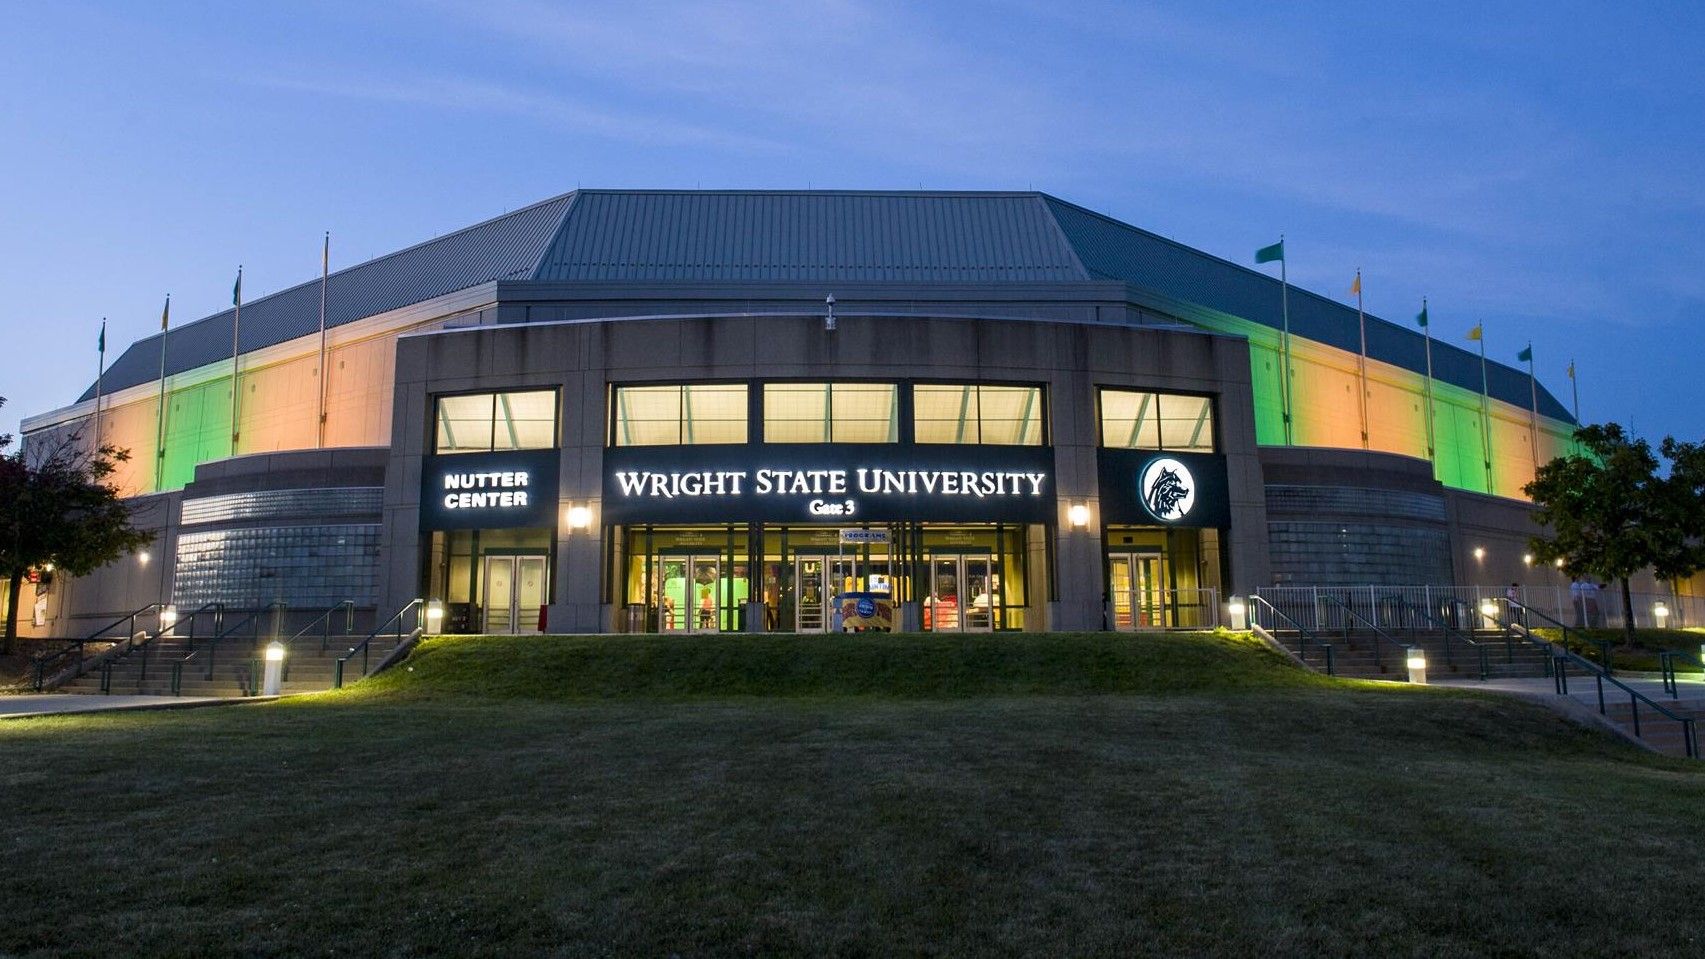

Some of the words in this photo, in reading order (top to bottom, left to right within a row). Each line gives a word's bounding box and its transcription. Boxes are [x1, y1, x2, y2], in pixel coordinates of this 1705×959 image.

[444, 471, 529, 489] NUTTER
[616, 471, 746, 498] WRIGHT
[756, 469, 846, 494] STATE
[857, 469, 1045, 497] UNIVERSITY
[444, 491, 528, 509] CENTER
[844, 499, 855, 515] 3
